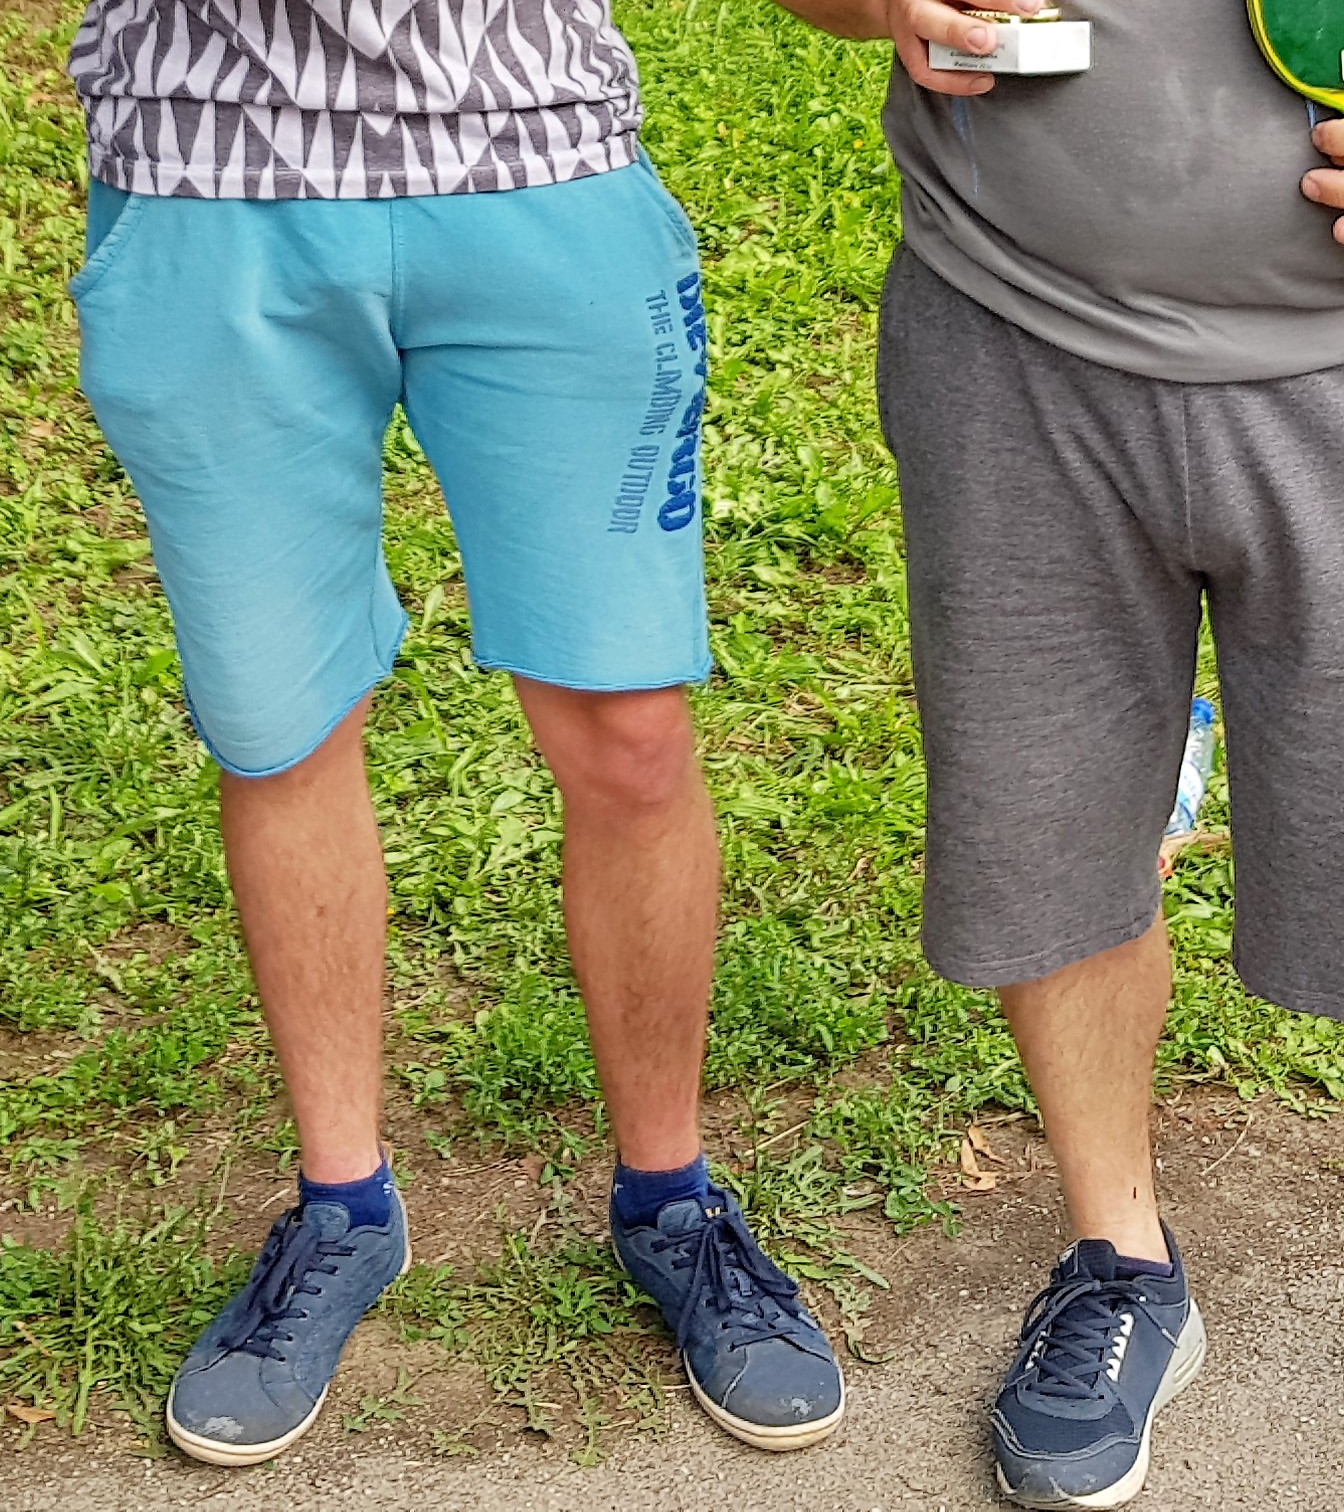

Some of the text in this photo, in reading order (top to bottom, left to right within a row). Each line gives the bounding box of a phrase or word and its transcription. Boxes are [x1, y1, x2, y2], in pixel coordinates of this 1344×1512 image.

[645, 289, 674, 335] THE
[639, 342, 683, 436] CLIMBING
[607, 444, 661, 534] OUTDOOR
